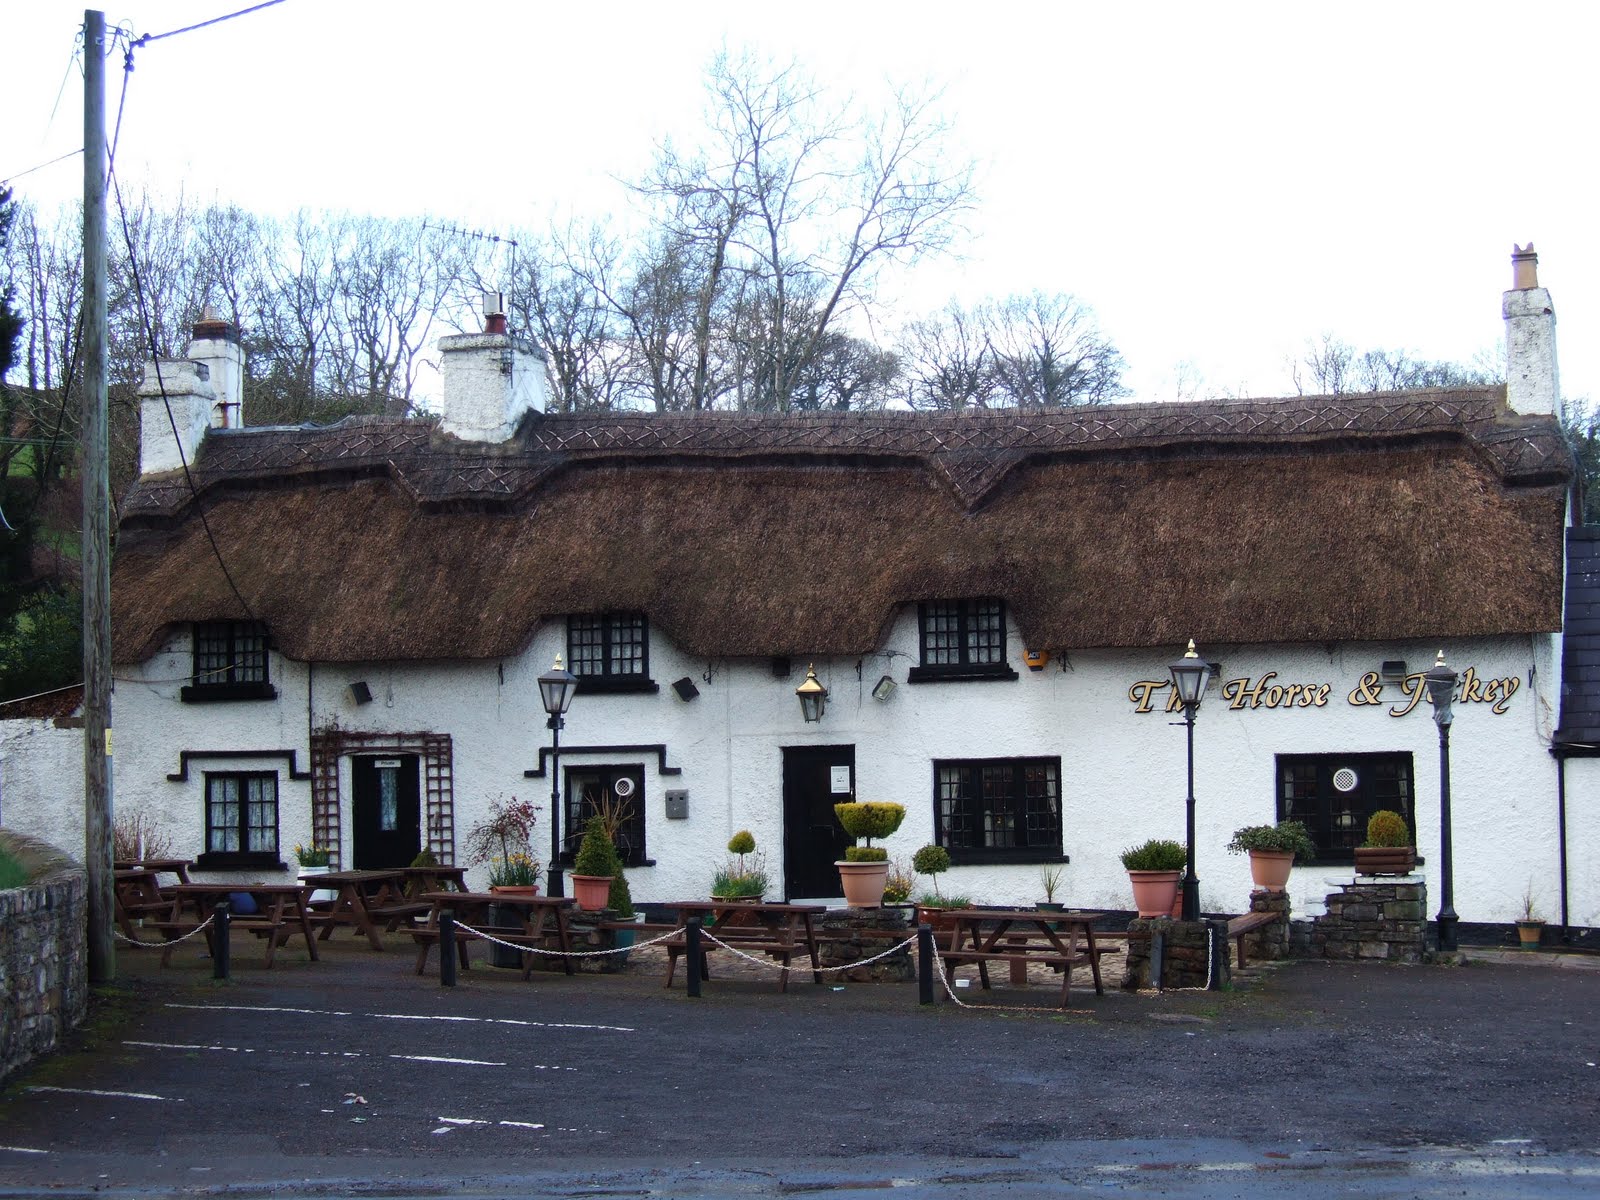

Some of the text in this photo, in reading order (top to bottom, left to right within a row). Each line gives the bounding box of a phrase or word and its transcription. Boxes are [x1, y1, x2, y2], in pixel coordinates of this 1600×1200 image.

[1128, 666, 1520, 717] Th Horse & Jkey
